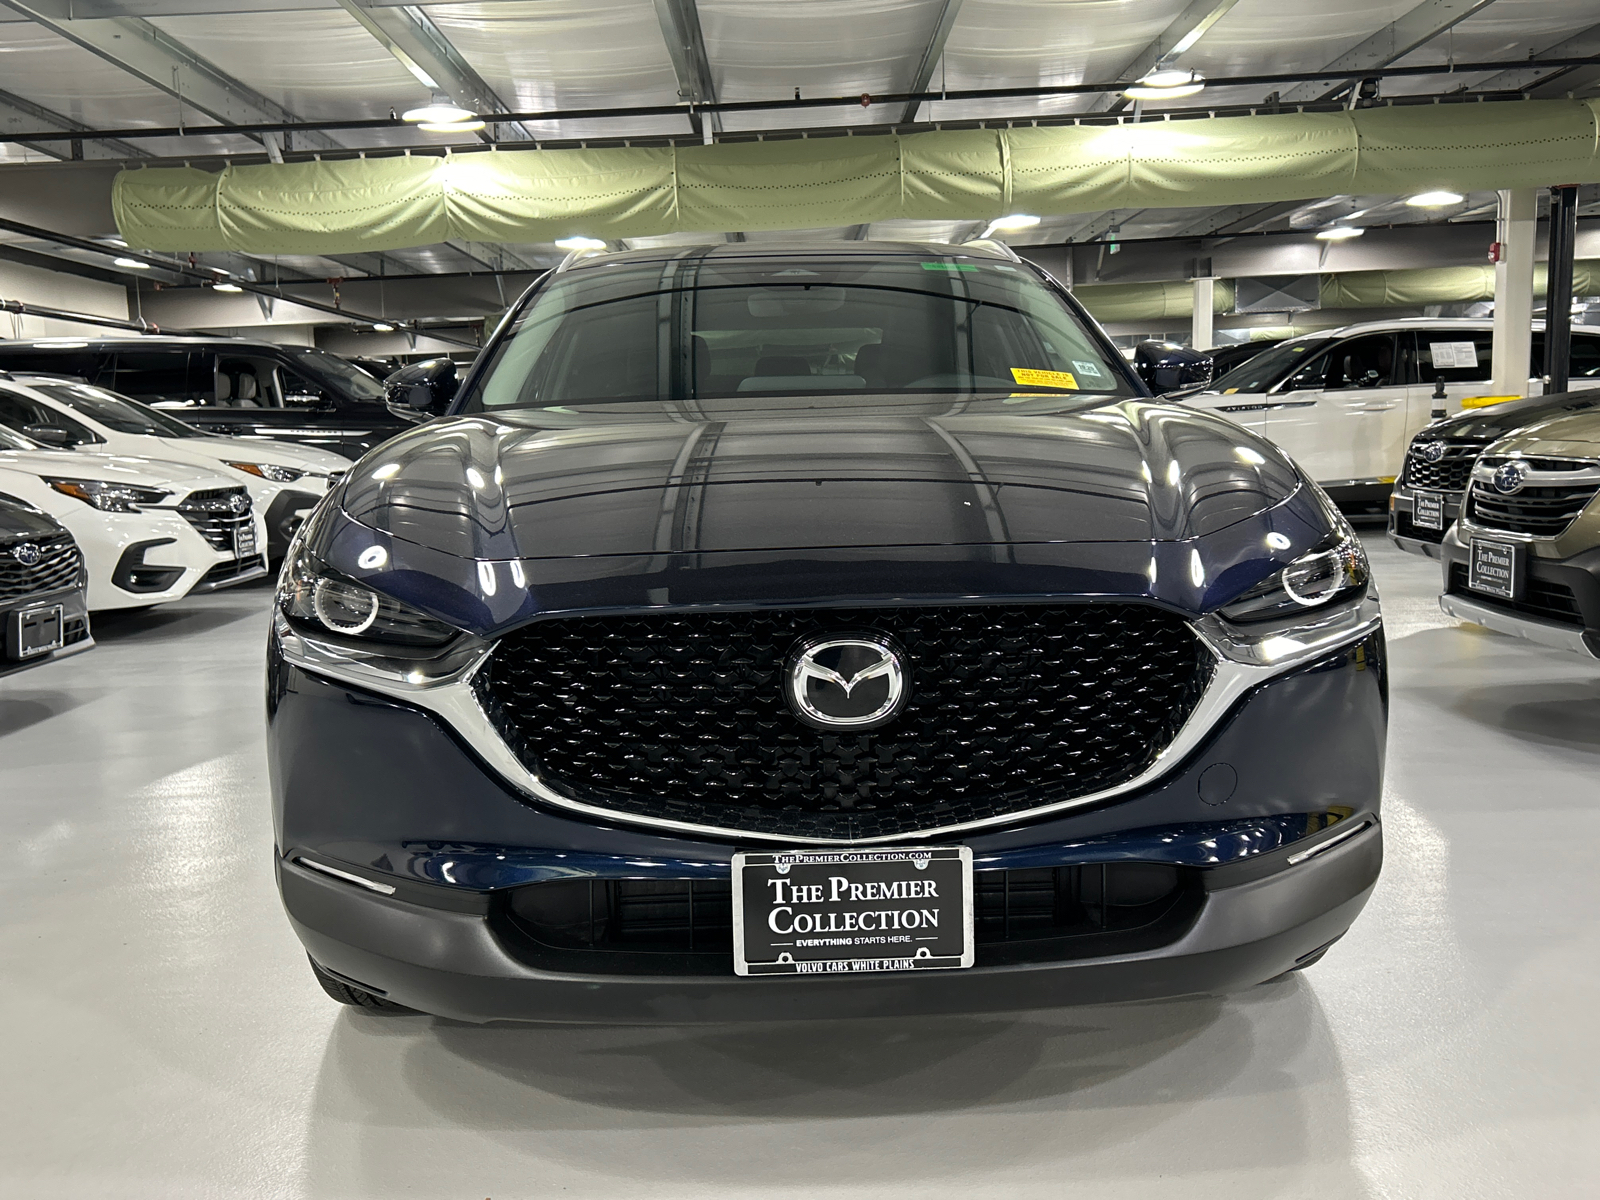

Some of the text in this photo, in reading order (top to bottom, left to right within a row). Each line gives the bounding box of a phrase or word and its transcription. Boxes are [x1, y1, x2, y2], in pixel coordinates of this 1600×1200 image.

[767, 876, 939, 904] THE PREMIER
[768, 906, 940, 934] COLLECTION
[796, 935, 913, 947] EVERYTHING STARTS HERE.
[795, 959, 915, 973] VOLVO CARS WHITE PLAINS
